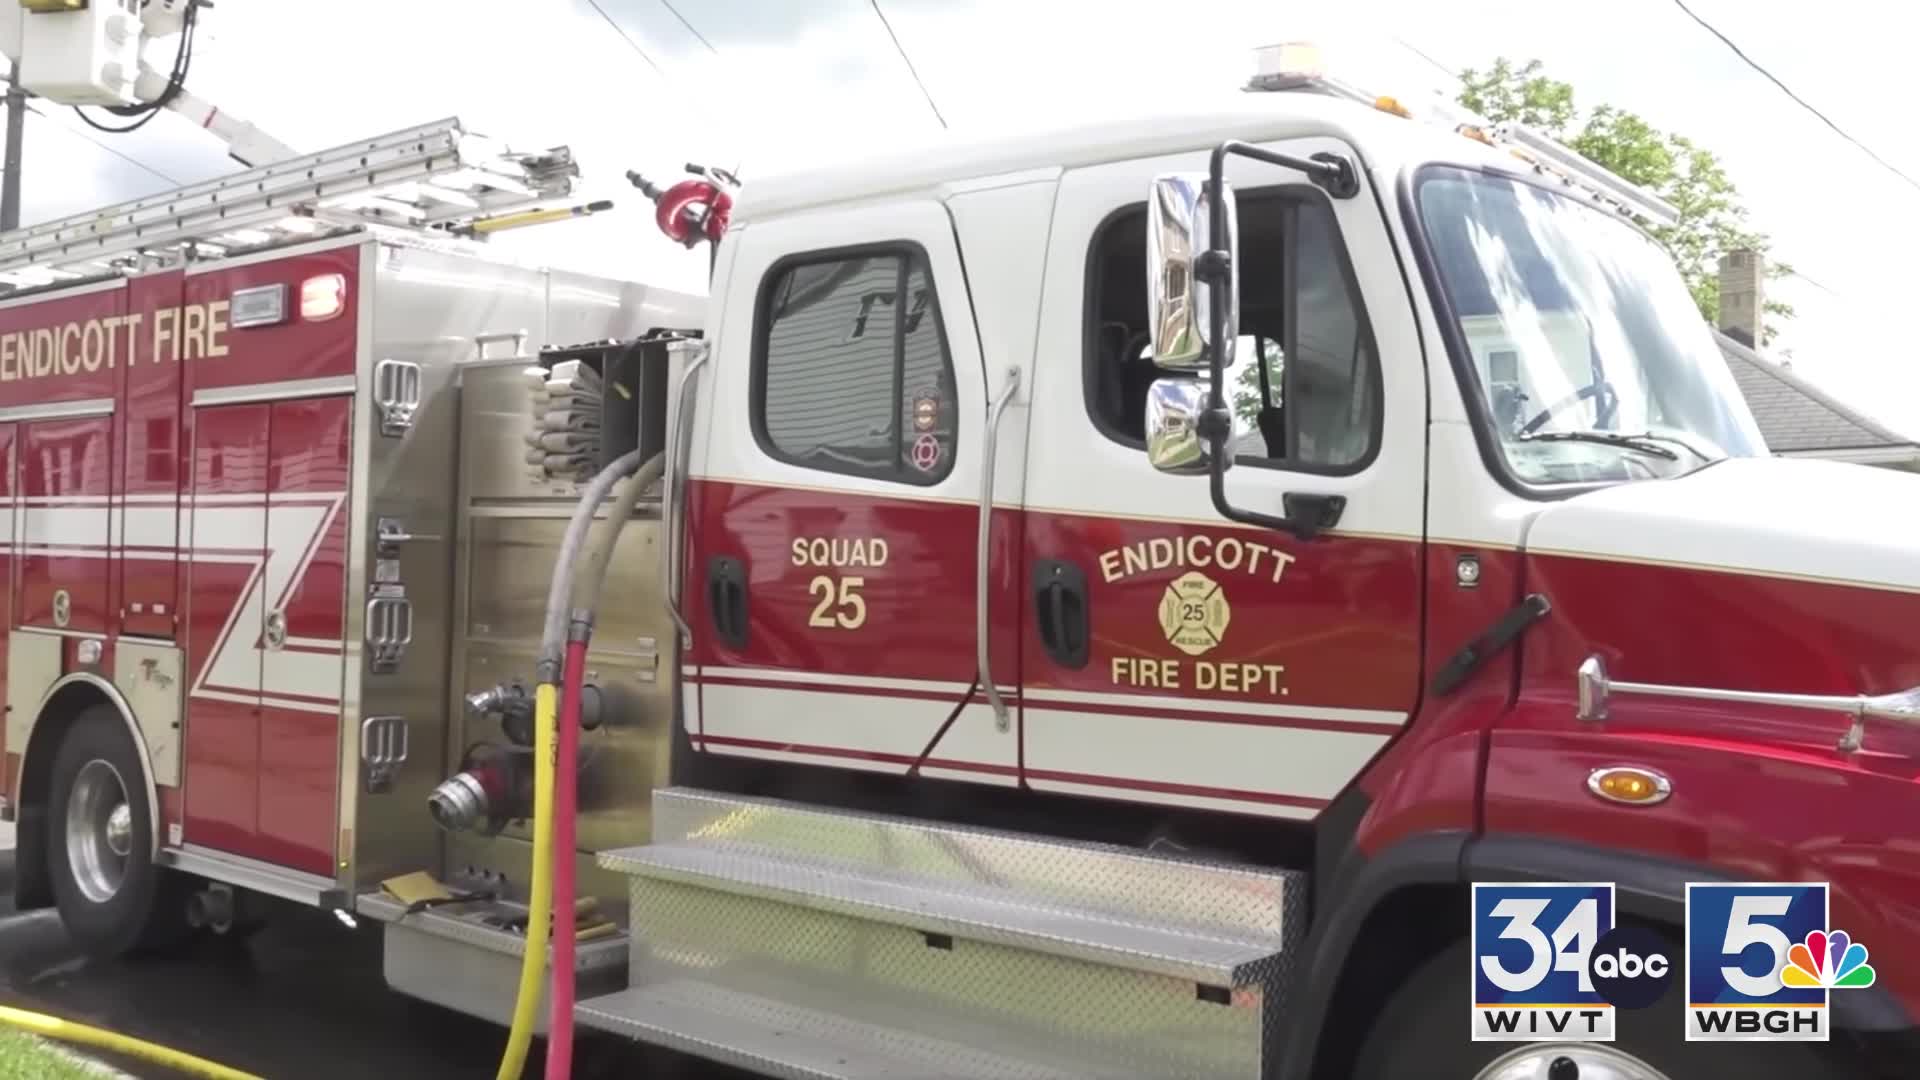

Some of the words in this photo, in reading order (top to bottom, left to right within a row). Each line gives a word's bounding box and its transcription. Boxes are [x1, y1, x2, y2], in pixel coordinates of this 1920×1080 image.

[1, 314, 142, 381] ENDICOTT
[153, 300, 229, 363] FIRE
[791, 537, 888, 567] SQUAD
[1099, 535, 1296, 583] ENDICOTT
[808, 575, 867, 629] 25
[1182, 581, 1204, 589] FIRE
[1182, 604, 1205, 621] 25
[1111, 657, 1180, 689] FIRE
[1195, 661, 1289, 695] DEPT.
